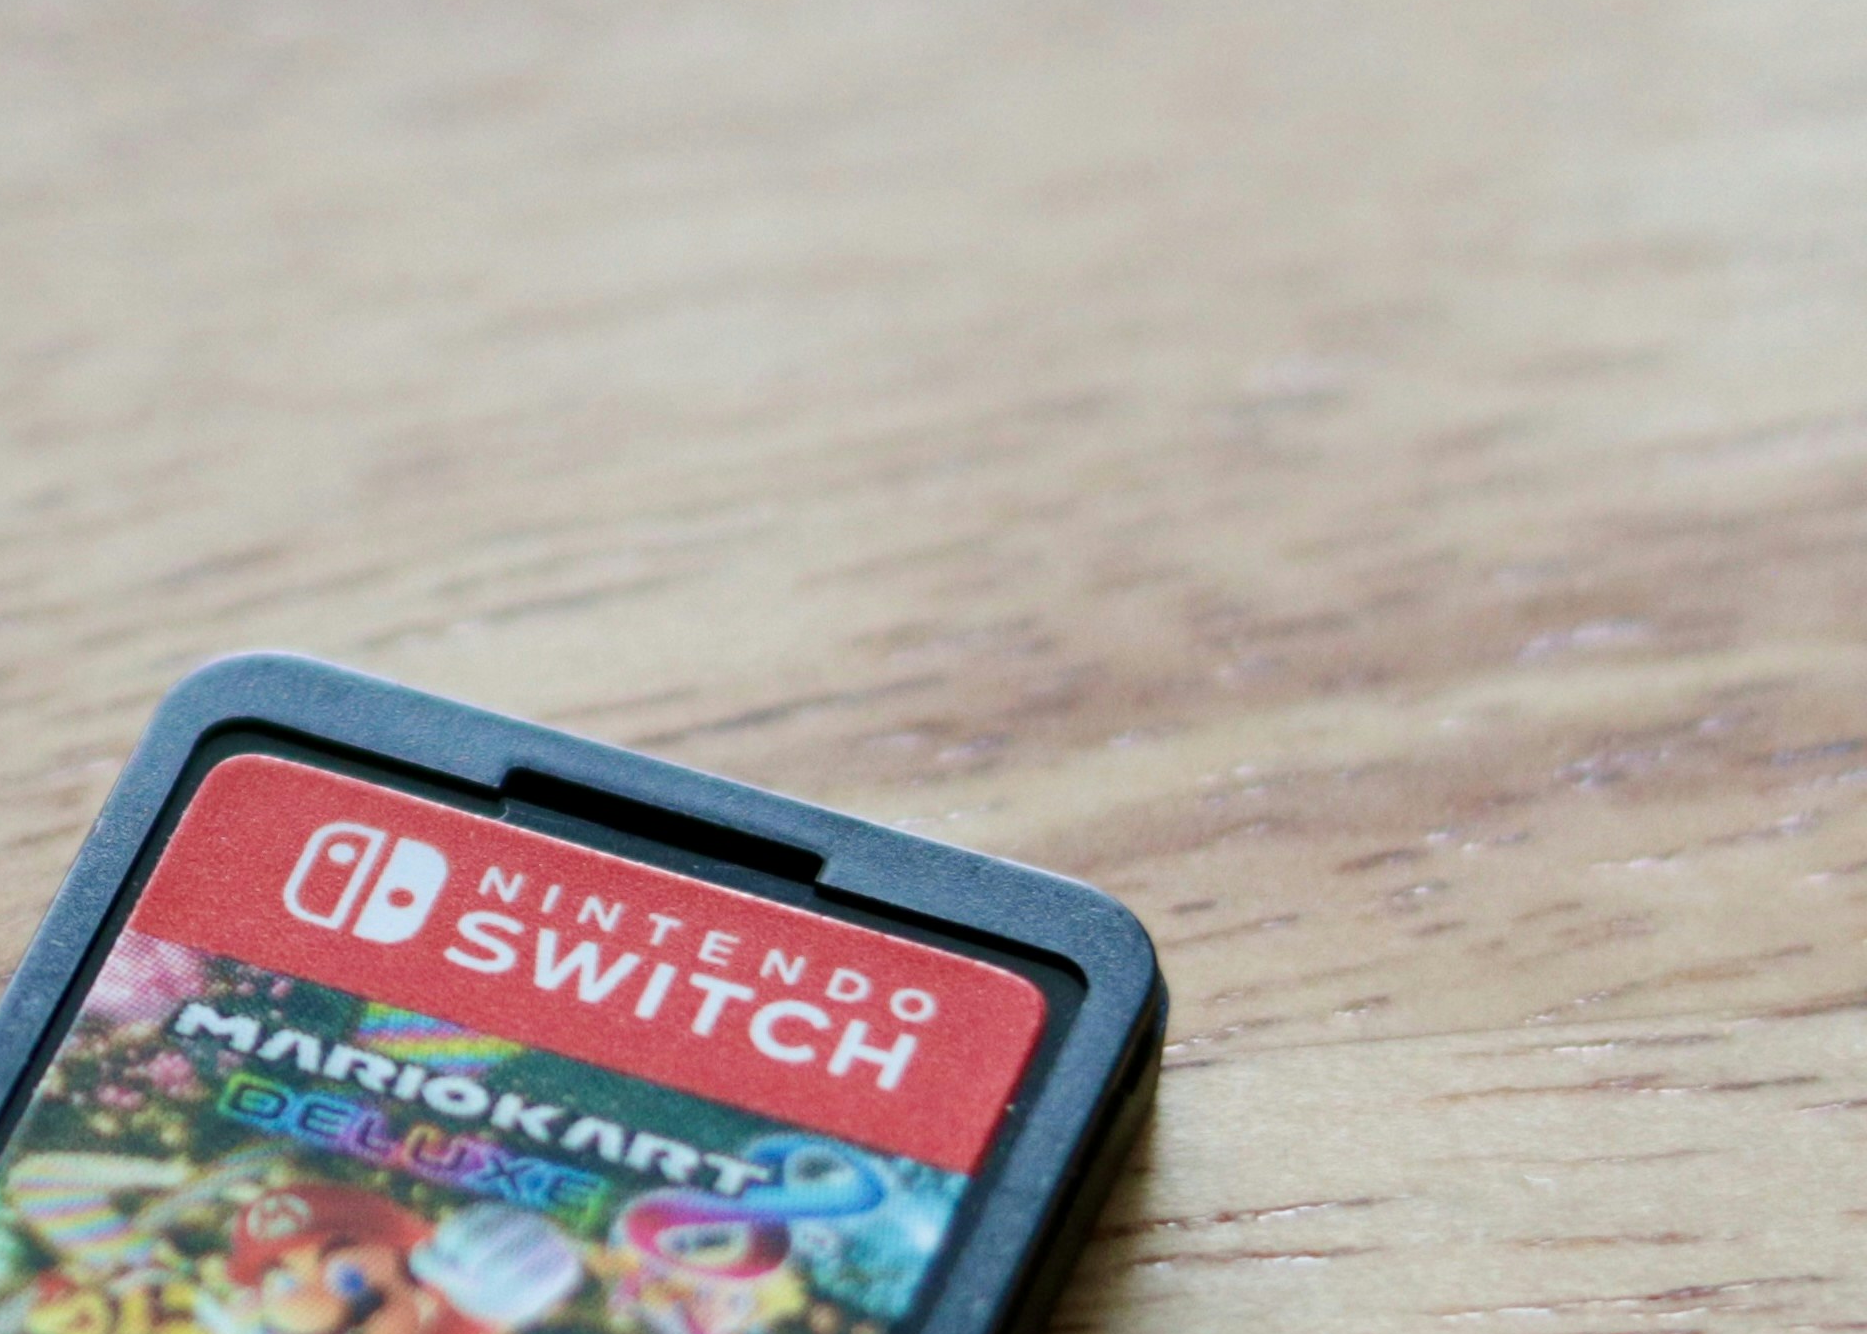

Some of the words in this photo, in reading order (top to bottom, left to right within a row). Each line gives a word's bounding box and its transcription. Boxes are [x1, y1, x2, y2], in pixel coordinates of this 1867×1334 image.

[444, 910, 919, 1093] SWITCH
[479, 865, 940, 1023] NINTENDO
[217, 1071, 613, 1229] DELUXE
